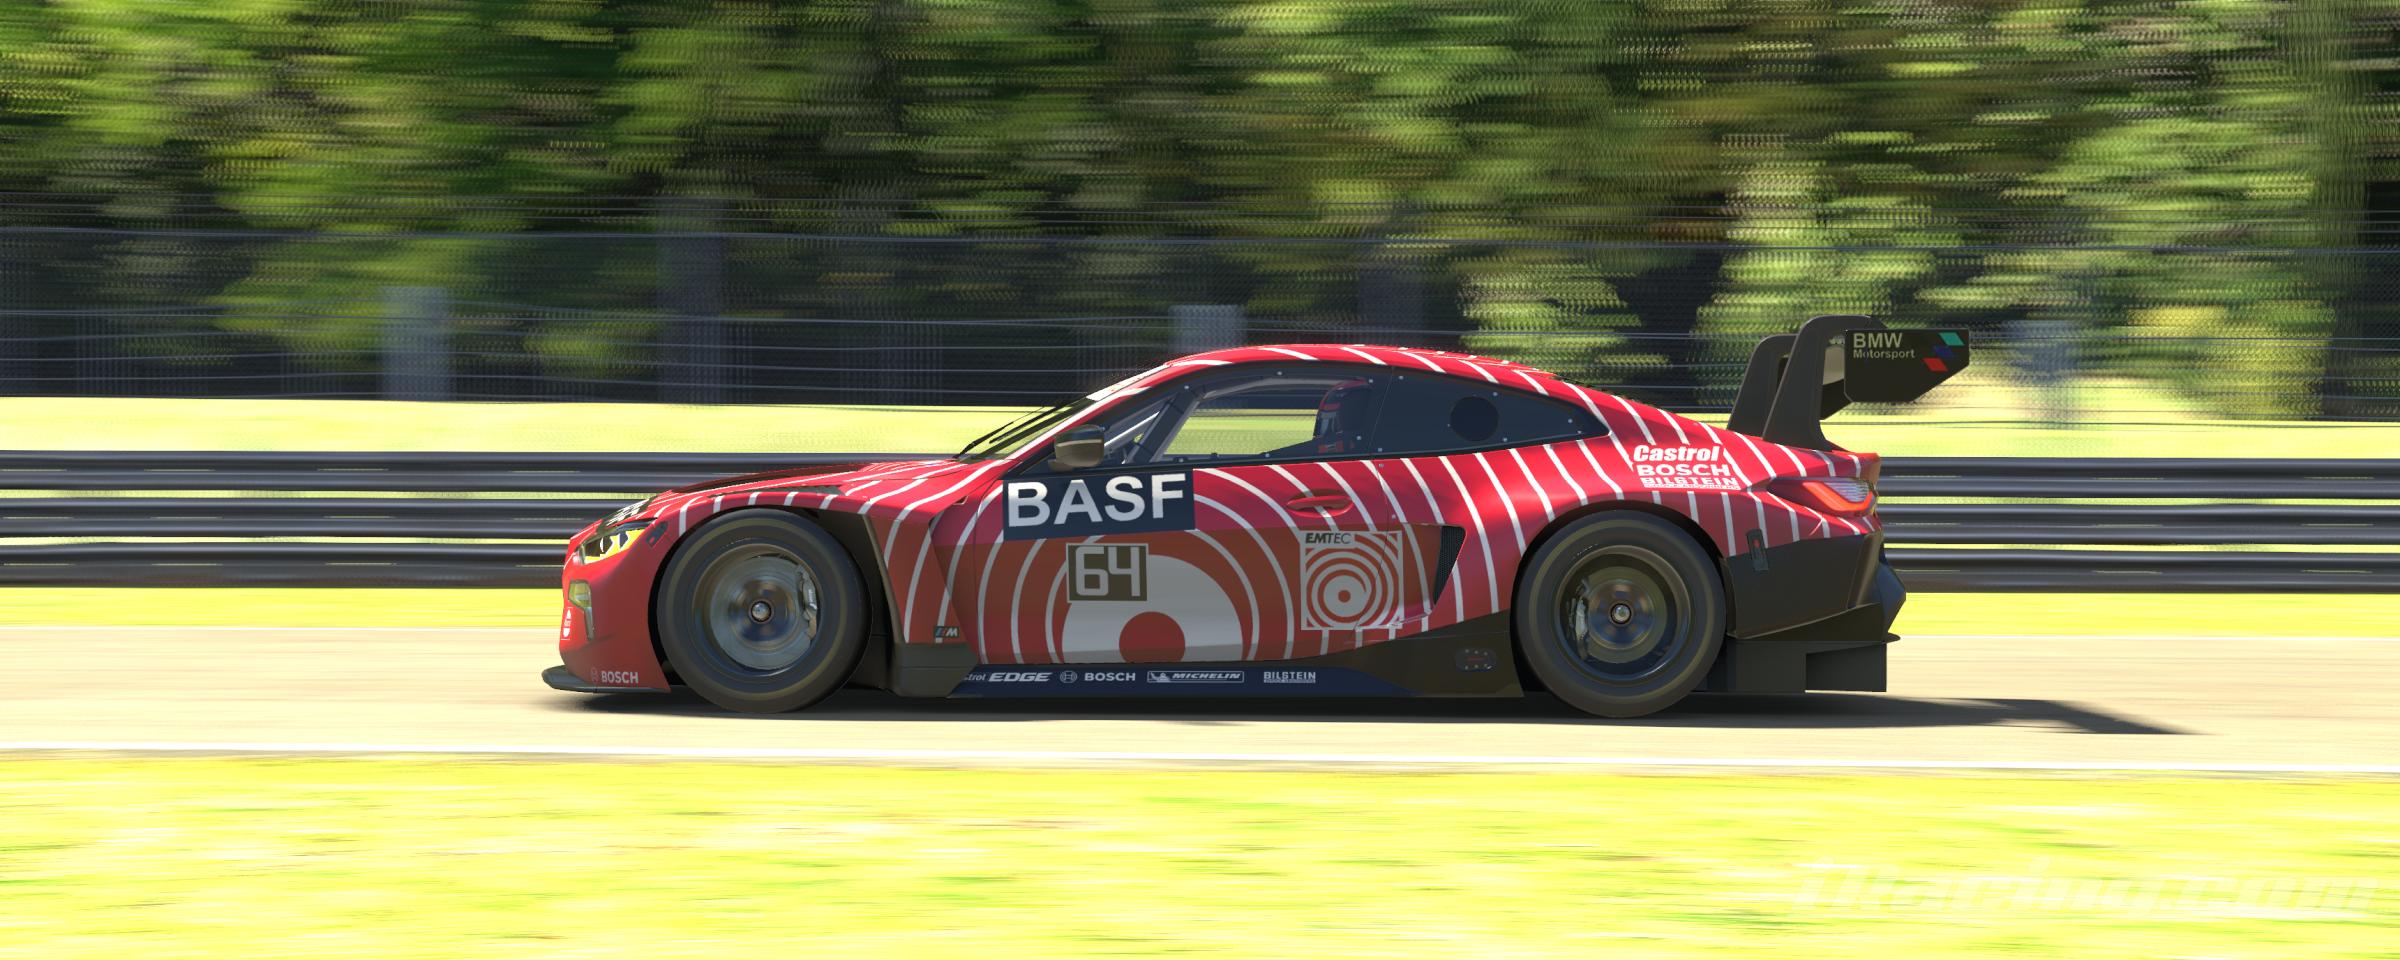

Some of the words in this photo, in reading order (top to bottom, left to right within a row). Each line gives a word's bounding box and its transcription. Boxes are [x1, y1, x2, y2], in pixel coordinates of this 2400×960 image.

[1853, 332, 1903, 348] BMW
[1853, 349, 1915, 360] Motorsport
[1633, 445, 1720, 462] Castrol
[1637, 464, 1731, 476] BOSCH
[1640, 477, 1739, 486] BILSTEIN
[1008, 473, 1187, 527] BASF
[1305, 532, 1352, 544] EMTEC
[1075, 546, 1140, 596] 64
[601, 671, 639, 684] BOSCH
[988, 672, 1053, 682] EDGE
[1084, 672, 1136, 682] BOSCH
[1263, 671, 1316, 680] BILSTEIN
